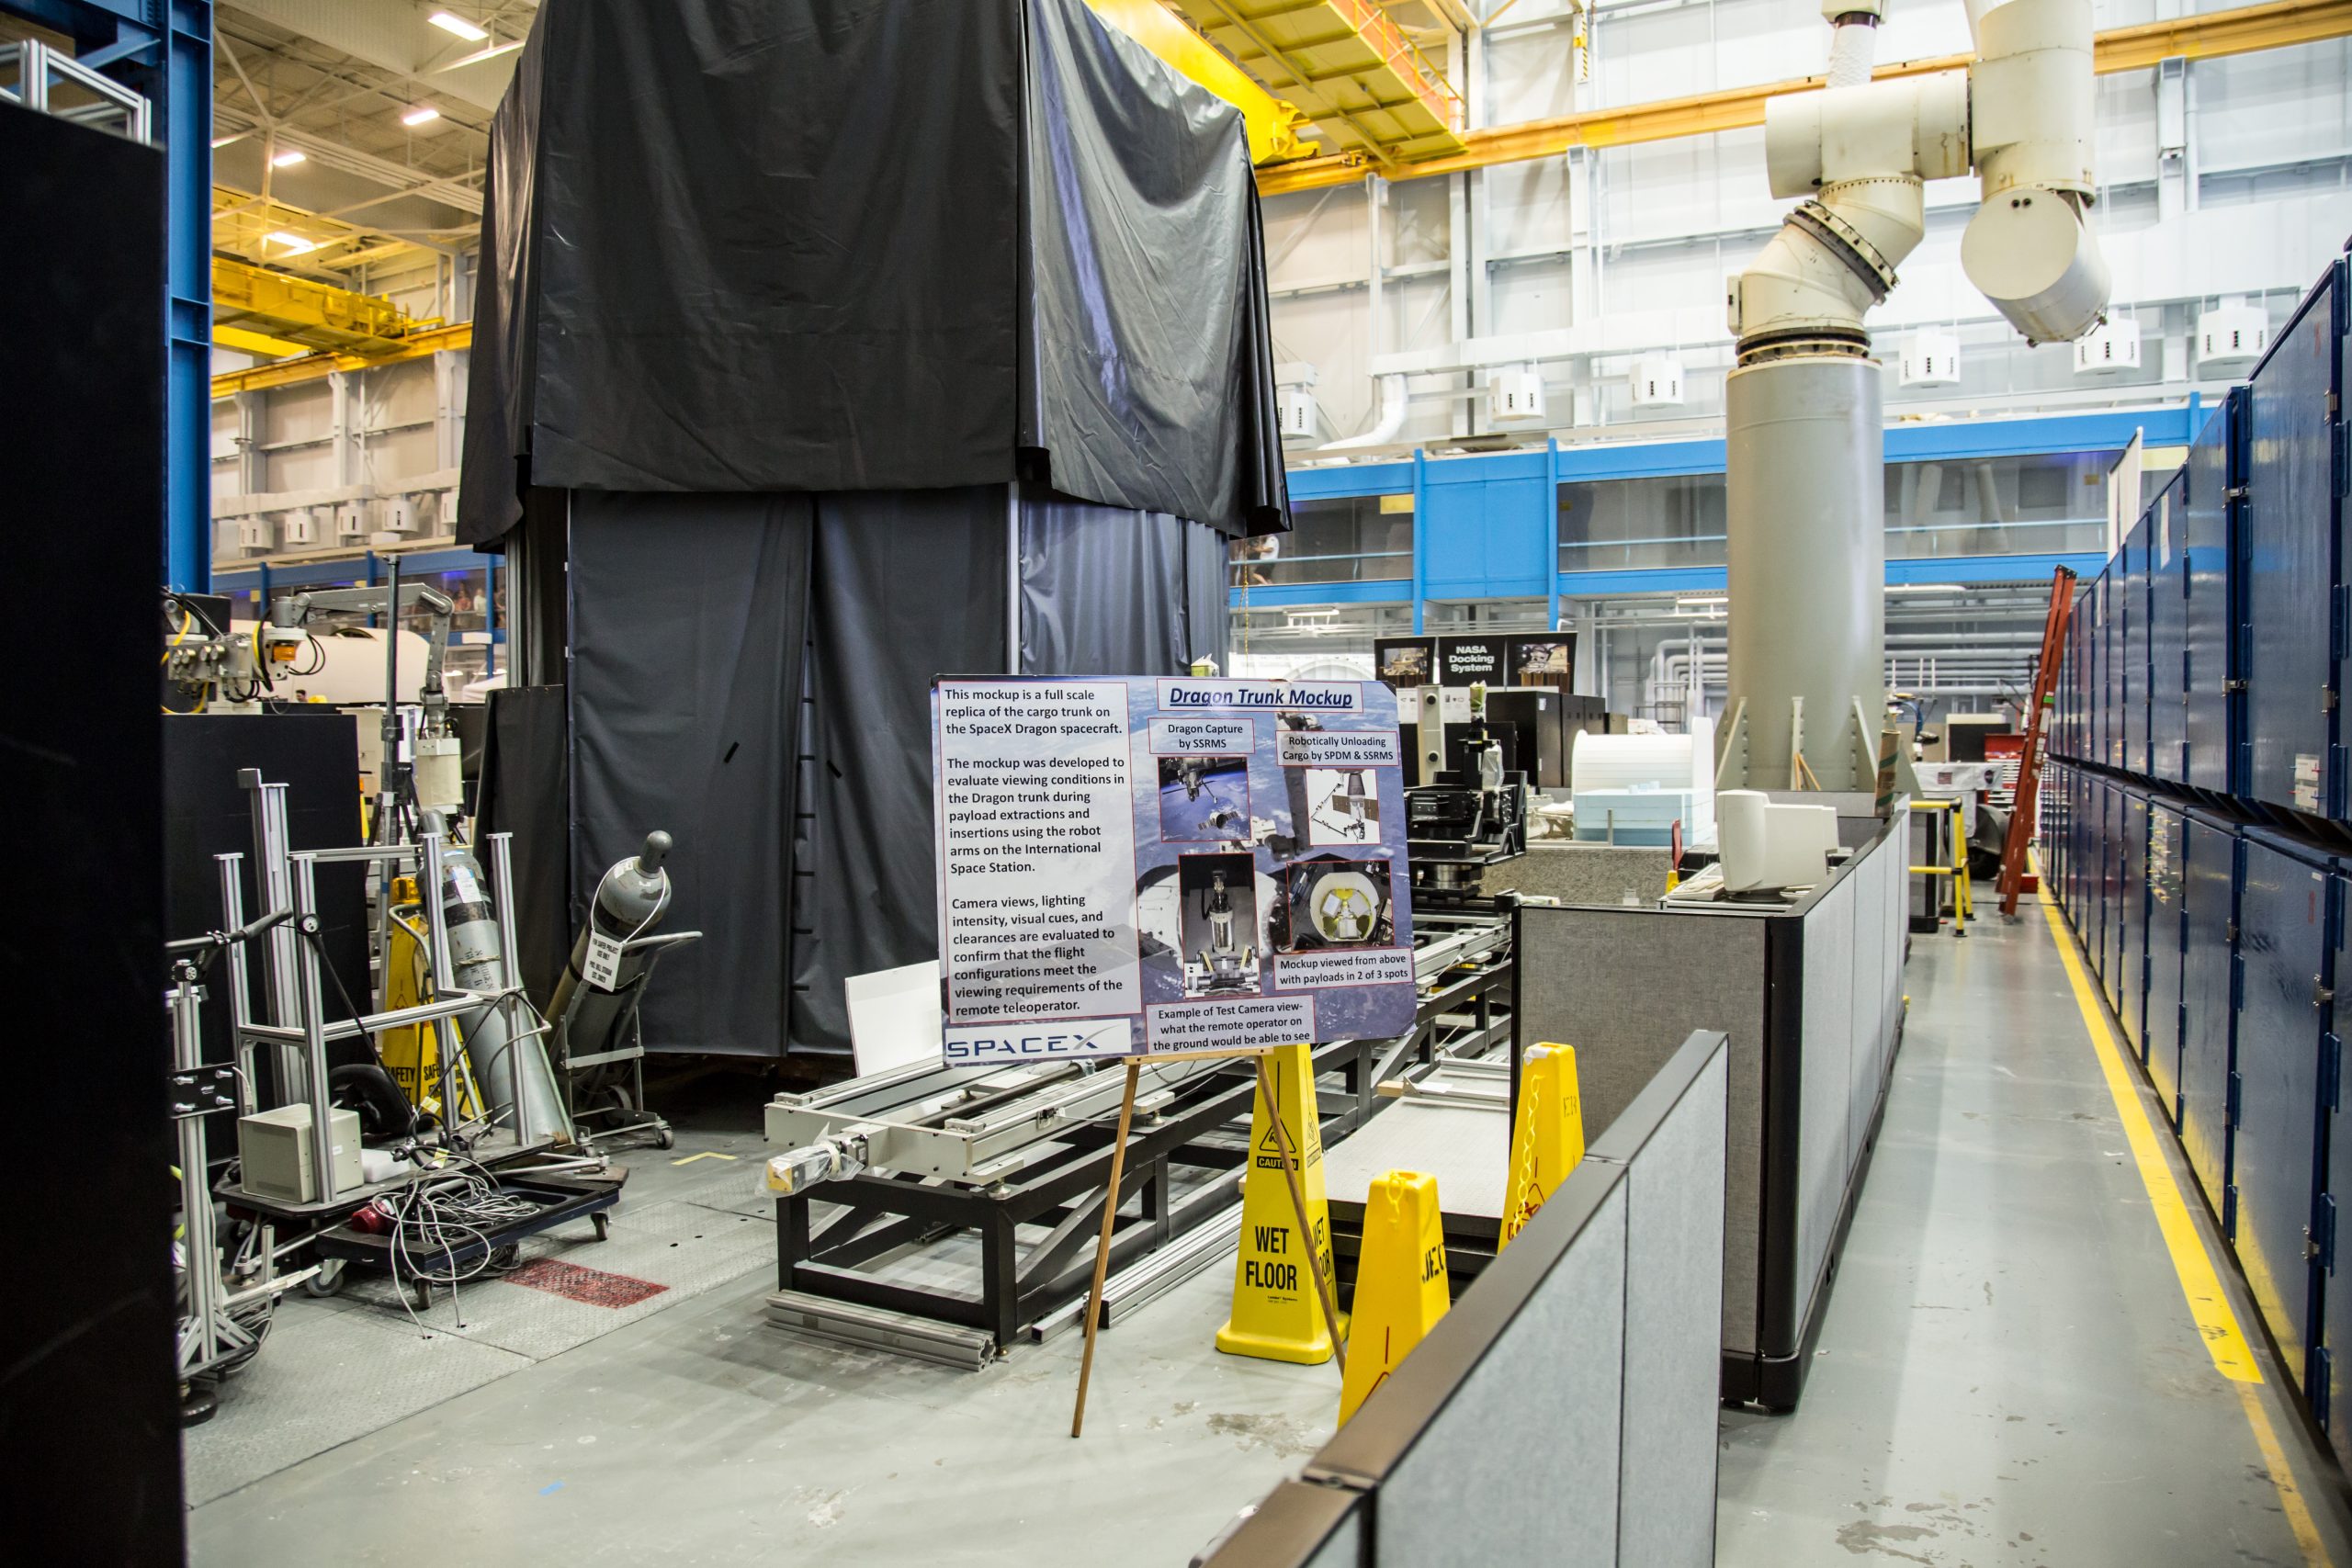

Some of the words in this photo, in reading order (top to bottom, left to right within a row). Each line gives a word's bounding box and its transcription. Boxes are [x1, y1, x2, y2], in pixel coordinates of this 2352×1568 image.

[1456, 645, 1487, 654] NASA
[1448, 655, 1495, 664] Docking
[1451, 663, 1493, 673] System
[944, 688, 969, 699] This
[972, 689, 1019, 702] mockup
[1023, 689, 1031, 699] is
[1044, 689, 1063, 700] full
[1066, 689, 1094, 700] scale
[1170, 687, 1233, 705] Dragon
[1238, 688, 1284, 705] Trunk
[1288, 689, 1353, 707] Mockup
[945, 705, 985, 718] replica
[989, 705, 1001, 716] of
[1003, 705, 1023, 716] the
[1026, 708, 1058, 719] cargo
[1060, 706, 1092, 716] trunk
[945, 723, 966, 734] the
[969, 723, 1012, 736] SpaceX
[1015, 723, 1057, 736] Dragon
[1060, 723, 1122, 736] spacecraft.
[1168, 724, 1203, 735] Dragon
[1204, 724, 1243, 735] Capture
[1179, 739, 1191, 750] by
[1193, 739, 1227, 748] SSRMS
[1289, 736, 1339, 748] Robotically
[1340, 736, 1385, 748] Unloading
[1283, 750, 1309, 761] Cargo
[1311, 750, 1322, 761] by
[1324, 750, 1351, 760] SPDM
[1353, 750, 1362, 760] &
[1363, 750, 1393, 760] SSRMS
[946, 757, 969, 768] The
[973, 757, 1020, 770] mockup
[1023, 760, 1046, 768] was
[1049, 756, 1109, 770] developed
[1112, 758, 1125, 767] to
[947, 774, 999, 786] evaluate
[1001, 774, 1047, 787] viewing
[1051, 773, 1111, 784] conditions
[1114, 773, 1124, 784] in
[948, 793, 968, 804] the
[972, 793, 1014, 805] Dragon
[1017, 791, 1049, 802] trunk
[1053, 791, 1091, 804] during
[949, 809, 996, 823] payload
[1000, 808, 1065, 820] extractions
[1068, 807, 1090, 818] and
[949, 827, 1009, 838] insertions
[1012, 826, 1043, 839] using
[1046, 825, 1066, 836] the
[1069, 825, 1101, 836] robot
[950, 847, 979, 856] arms
[983, 847, 998, 855] on
[1001, 843, 1022, 854] the
[1025, 841, 1101, 853] International
[950, 863, 986, 875] Space
[989, 861, 1035, 873] Station.
[952, 898, 997, 908] Camera
[1001, 897, 1038, 908] views,
[1042, 895, 1085, 908] lighting
[953, 914, 1008, 928] intensity,
[1011, 912, 1045, 924] visual
[1048, 914, 1078, 924] cues,
[1081, 910, 1102, 921] and
[953, 933, 1016, 944] clearances
[1019, 933, 1038, 942] are
[1042, 928, 1099, 941] evaluated
[1102, 929, 1114, 938] to
[954, 950, 1001, 962] confirm
[1003, 949, 1028, 961] that
[1031, 947, 1051, 959] the
[1054, 946, 1085, 960] flight
[1280, 959, 1318, 970] Mockup
[1319, 956, 1352, 967] viewed
[1354, 955, 1376, 965] from
[1379, 954, 1406, 964] above
[954, 966, 1040, 981] configurations
[1044, 964, 1074, 976] meet
[1077, 963, 1096, 974] the
[1279, 974, 1301, 985] with
[1303, 971, 1344, 985] payloads
[1346, 971, 1354, 980] in
[1357, 971, 1363, 979] 2
[1364, 969, 1374, 979] of
[1376, 969, 1382, 978] 3
[1385, 969, 1408, 980] spots
[955, 986, 1002, 998] viewing
[1005, 982, 1085, 997] requirements
[1088, 979, 1101, 991] of
[1102, 979, 1123, 990] the
[956, 1004, 1000, 1016] remote
[1002, 1000, 1080, 1014] teleoperator.
[1159, 1008, 1201, 1020] Example
[1203, 1006, 1214, 1016] of
[1216, 1006, 1236, 1015] Test
[1238, 1004, 1274, 1014] Camera
[1276, 1001, 1303, 1011] view-
[1159, 1024, 1186, 1034] what
[1188, 1022, 1205, 1032] the
[1207, 1021, 1243, 1032] remote
[1246, 1018, 1288, 1031] operator
[1290, 1018, 1302, 1026] on
[947, 1030, 1107, 1058] SPACEX
[1153, 1040, 1170, 1050] the
[1172, 1037, 1208, 1051] ground
[1211, 1034, 1241, 1046] would
[1244, 1034, 1256, 1043] be
[1259, 1032, 1279, 1043] able
[1281, 1032, 1292, 1042] to
[1294, 1032, 1310, 1041] see
[1259, 1157, 1297, 1170] CAUT
[1255, 1225, 1289, 1255] WET
[1245, 1260, 1297, 1292] FLOOR
